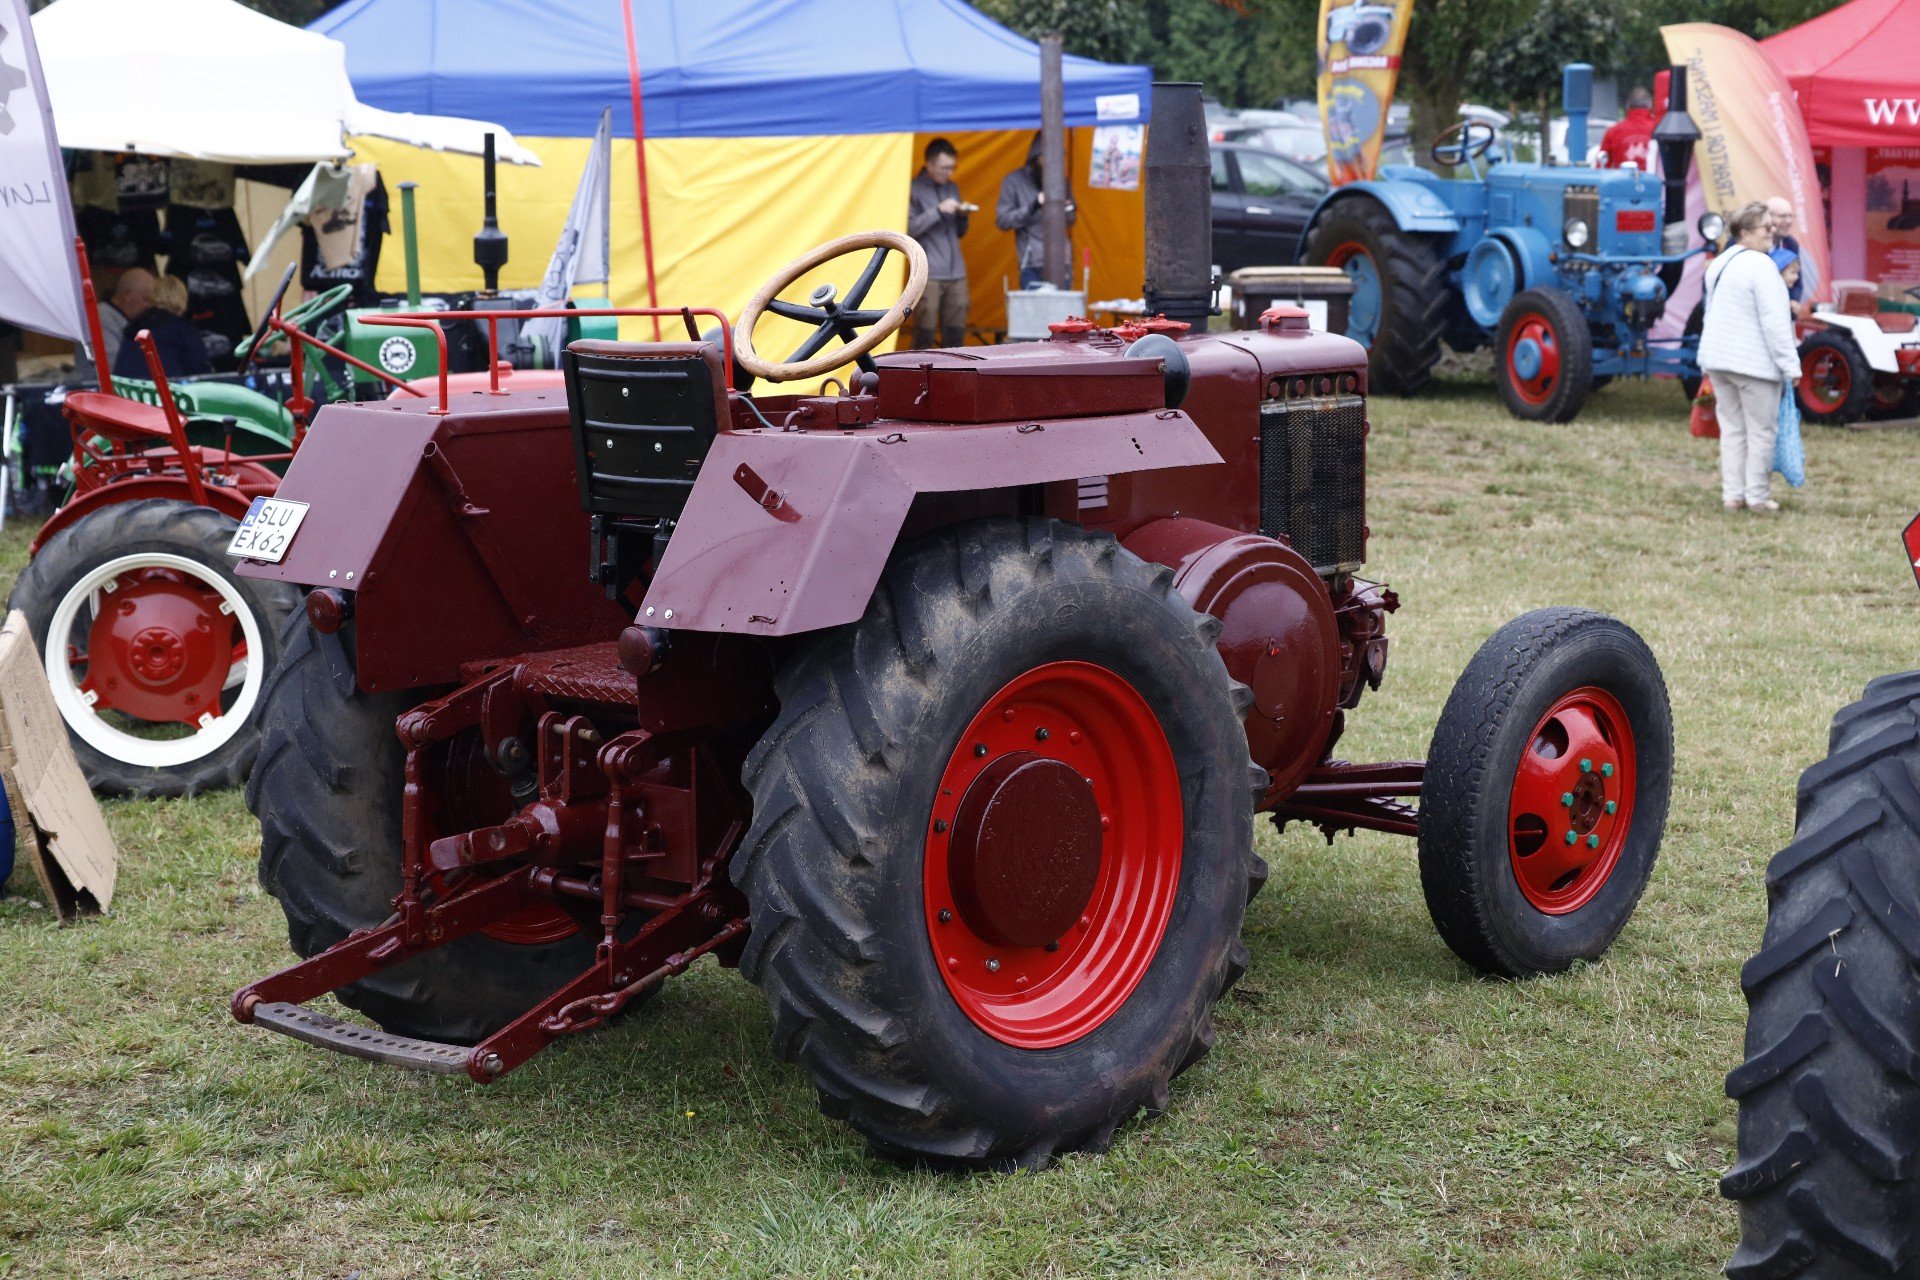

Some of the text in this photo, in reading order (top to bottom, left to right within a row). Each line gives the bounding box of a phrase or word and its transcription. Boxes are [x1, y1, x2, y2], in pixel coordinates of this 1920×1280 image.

[245, 505, 294, 527] PL SLU
[234, 529, 285, 553] EX62
